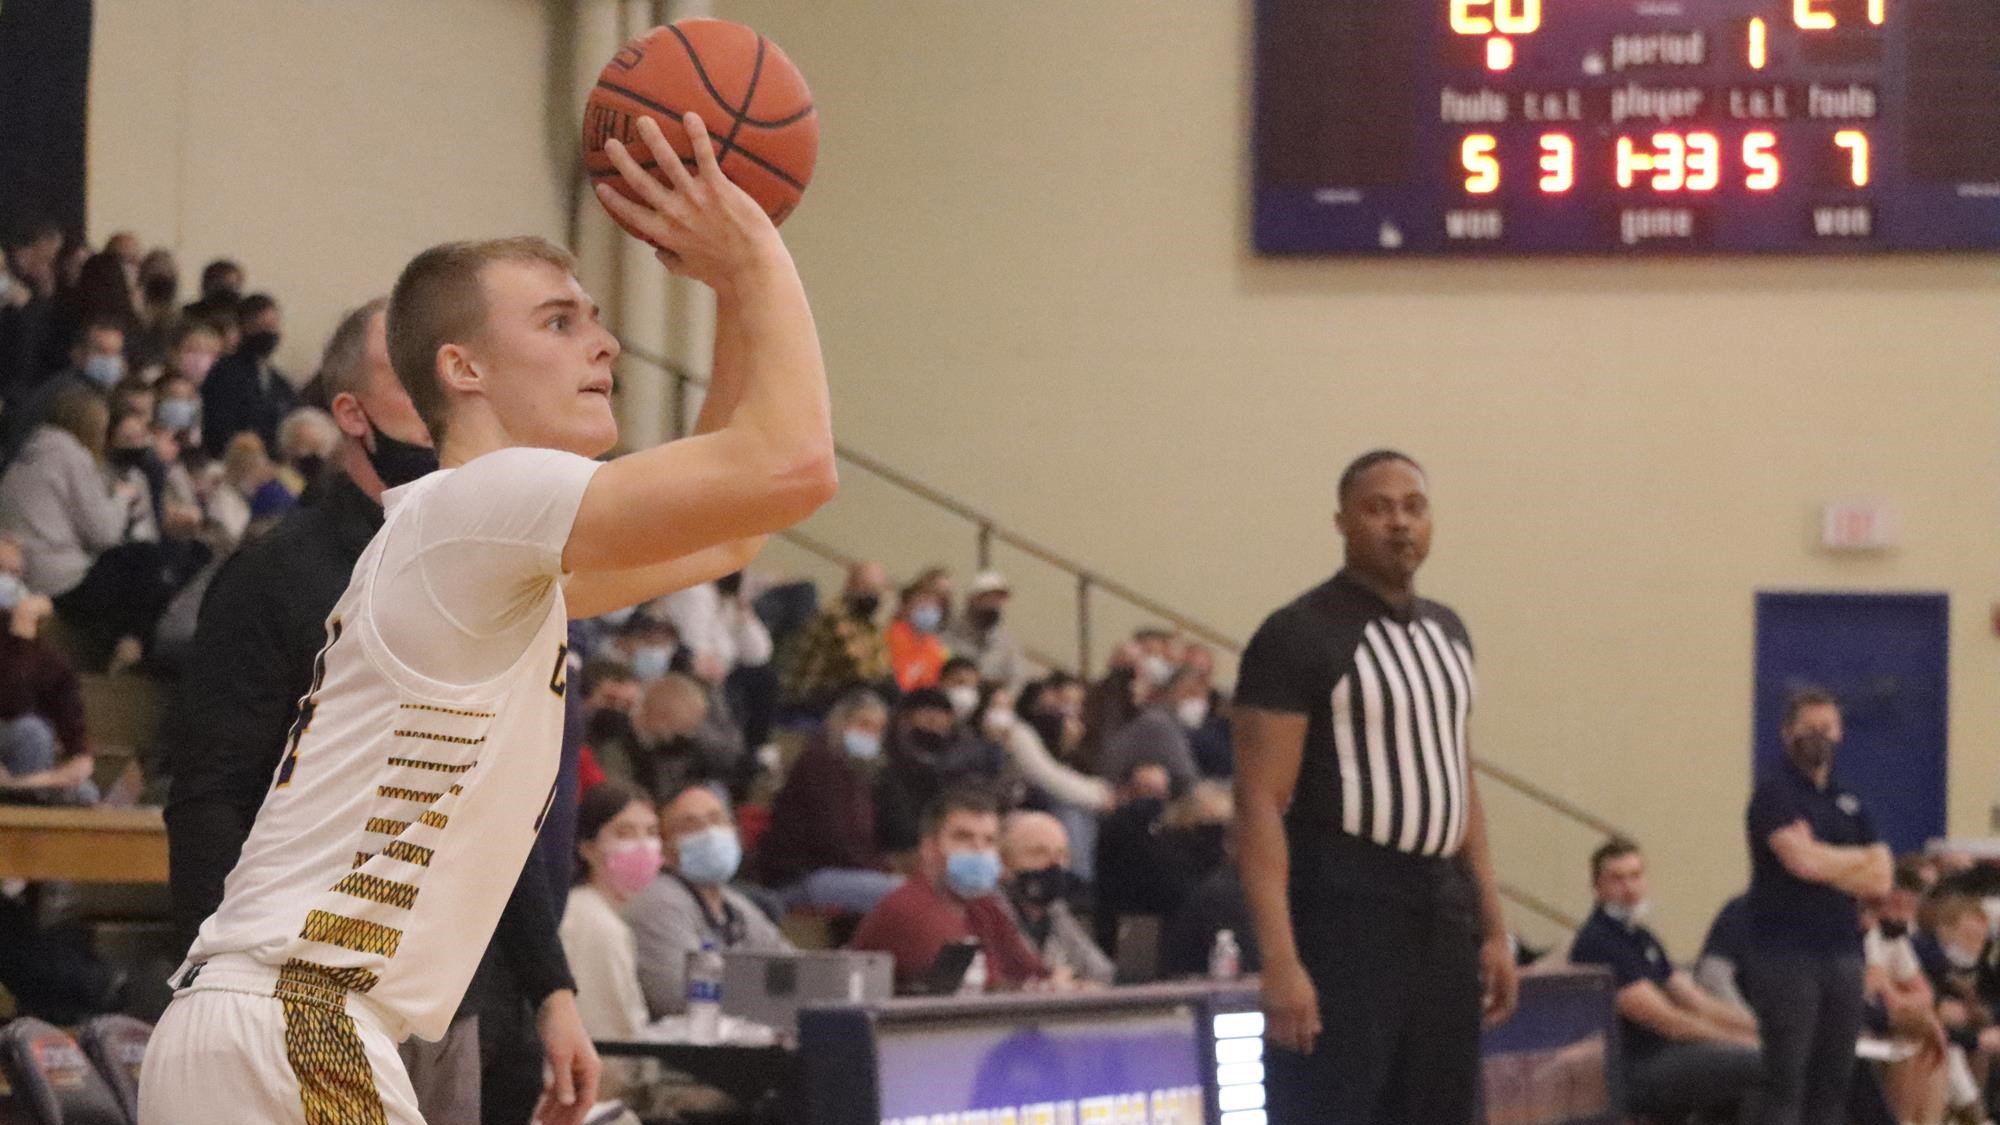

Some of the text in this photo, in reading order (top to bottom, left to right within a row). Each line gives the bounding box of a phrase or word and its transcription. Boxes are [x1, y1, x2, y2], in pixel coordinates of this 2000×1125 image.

[1462, 134, 1499, 193] 5
[1539, 134, 1573, 192] 3
[1743, 132, 1779, 190] 5
[1834, 131, 1868, 186] 7
